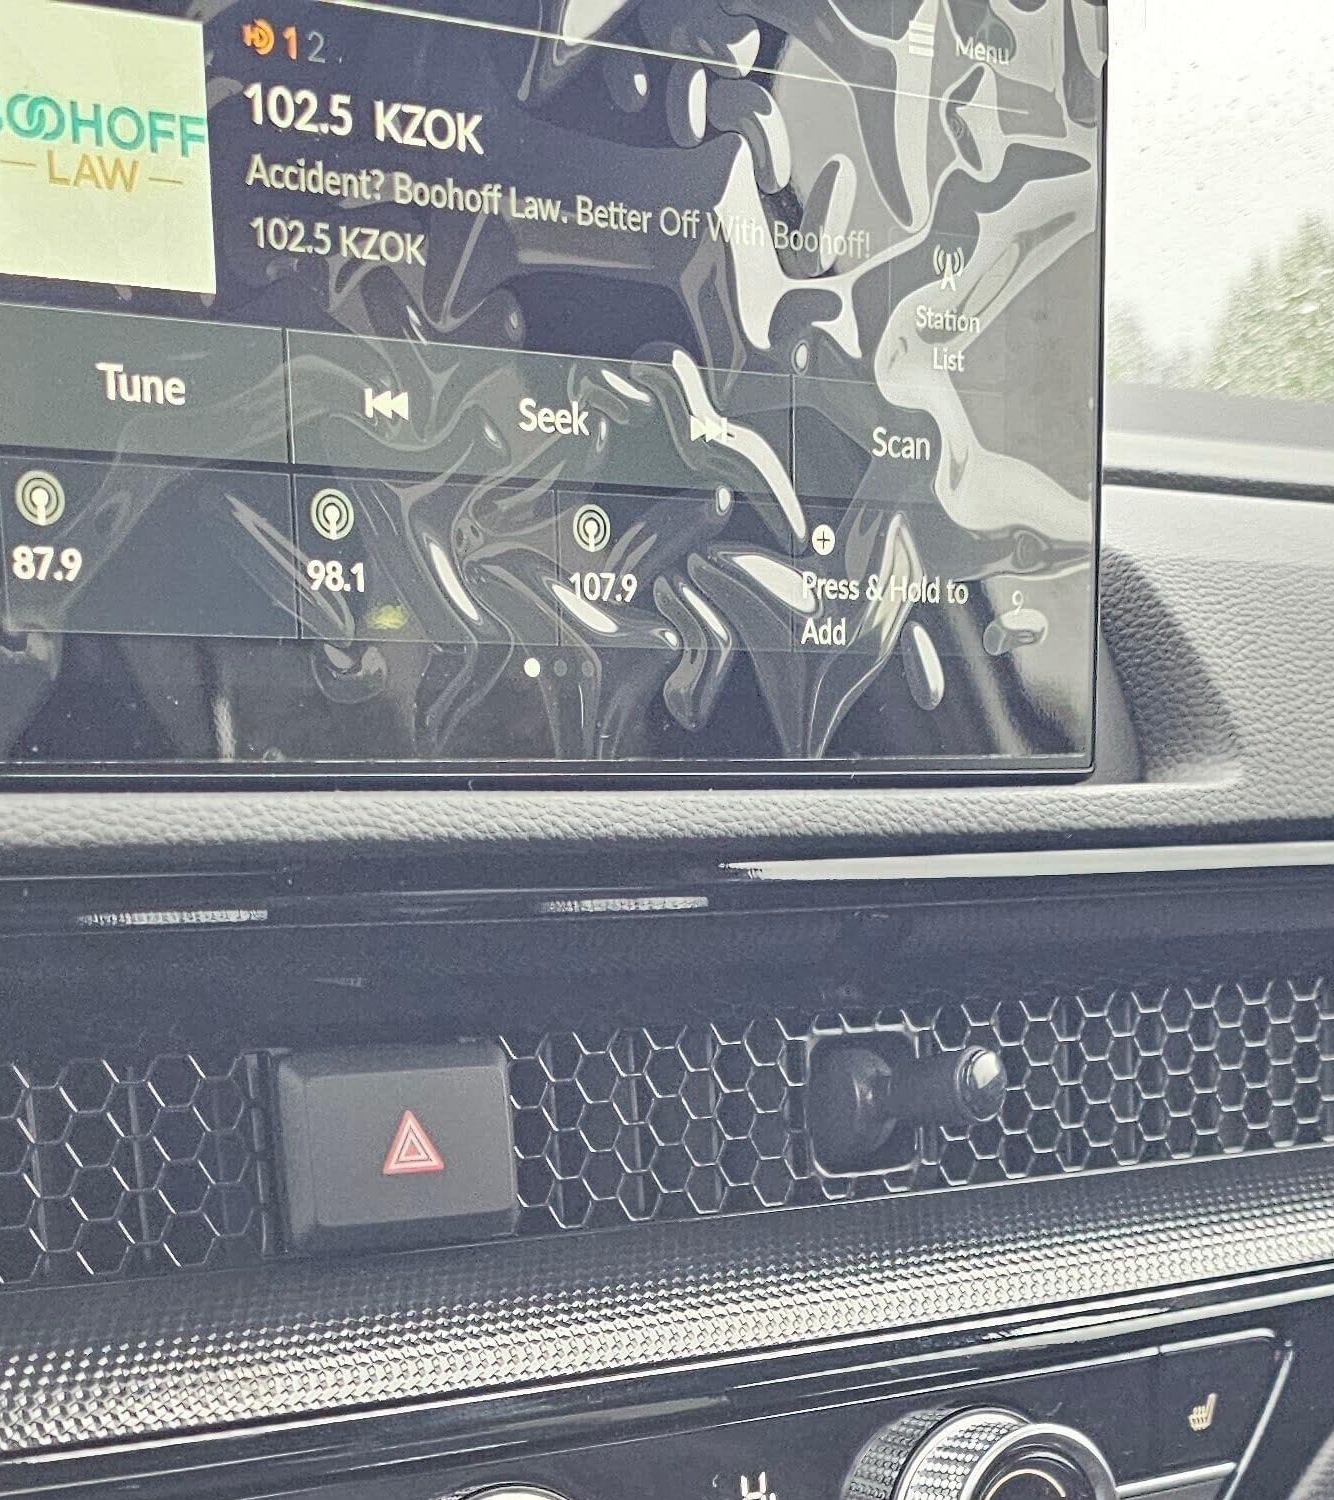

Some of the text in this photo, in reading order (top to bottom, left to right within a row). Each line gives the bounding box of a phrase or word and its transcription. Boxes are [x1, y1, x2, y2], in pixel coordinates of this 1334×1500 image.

[283, 26, 297, 59] 1
[307, 31, 326, 63] 2
[956, 37, 1011, 65] Menu
[243, 83, 484, 155] 102.5 KZOK
[47, 149, 139, 193] LAW
[246, 153, 871, 259] Accident? Boohoff Law. Better Off With Boohoff!
[250, 216, 427, 267] 102.5 KZOK
[915, 305, 981, 334] Station
[933, 347, 965, 373] List
[95, 361, 187, 407] Tune
[519, 397, 591, 438] Seek
[872, 427, 931, 461] Scan
[11, 546, 83, 584] 87.9
[306, 559, 366, 594] 98.1
[569, 571, 638, 604] 107.9
[801, 570, 969, 605] Press & Hold to
[801, 618, 847, 645] Add
